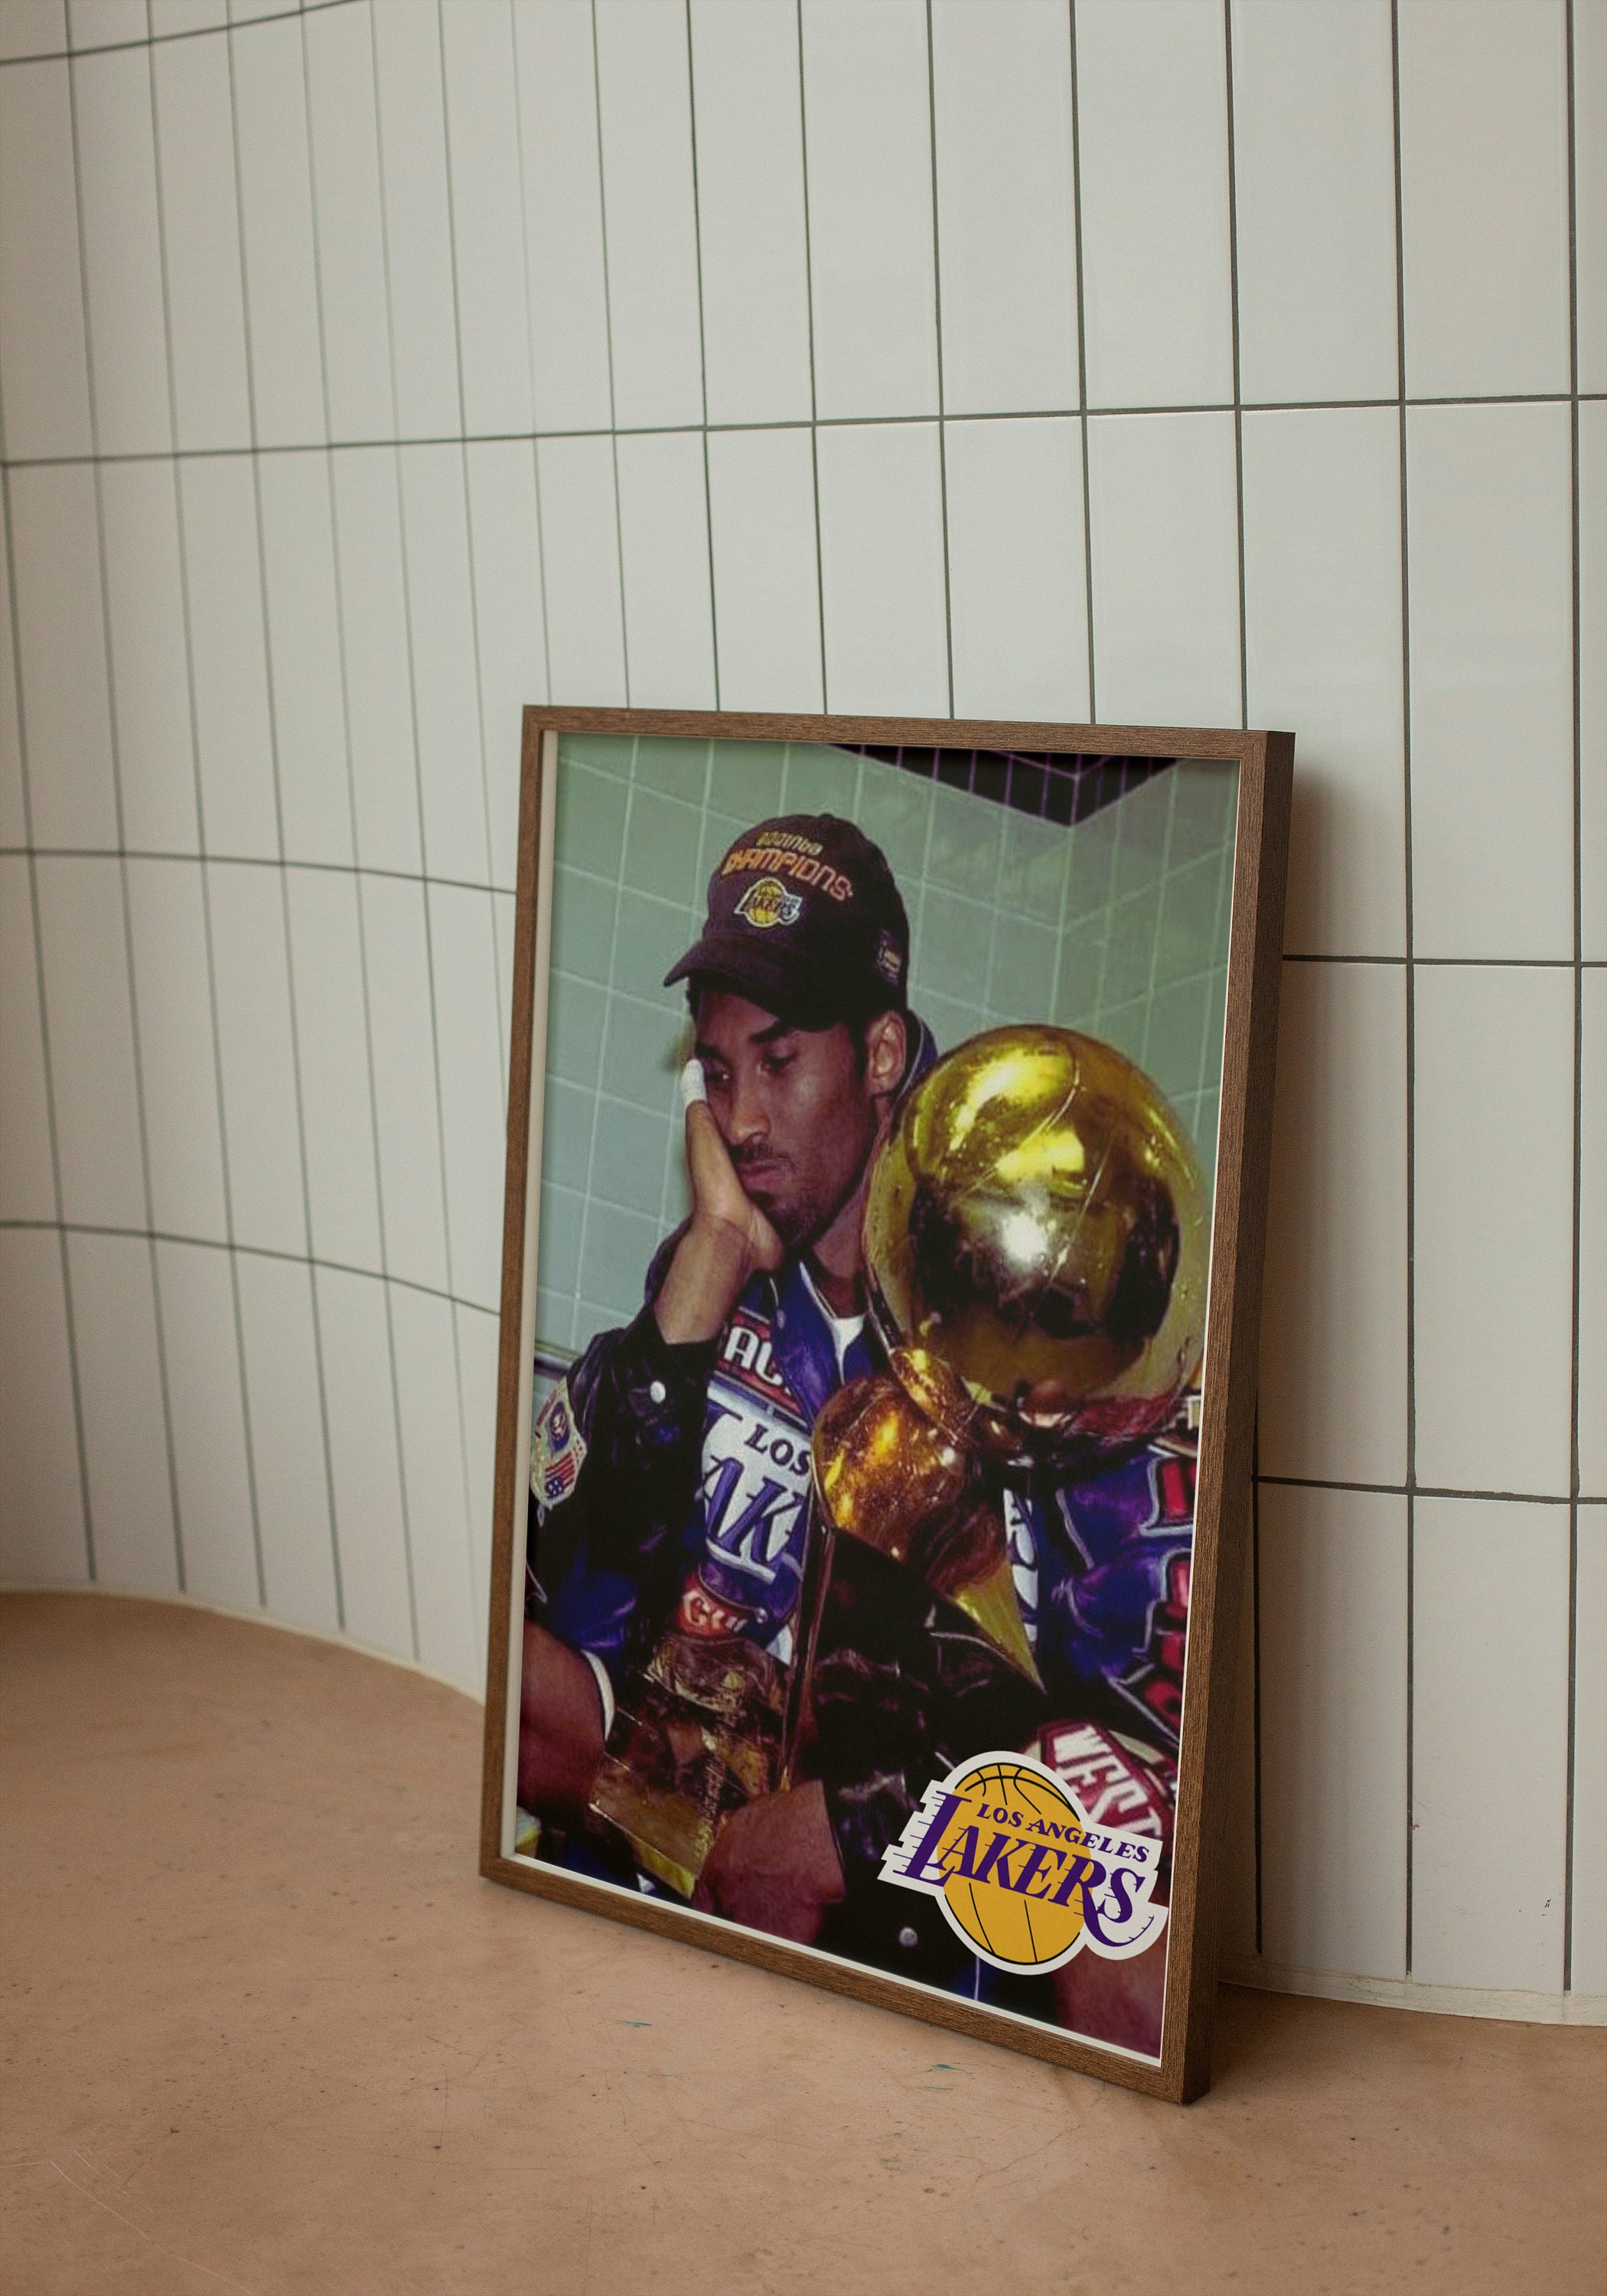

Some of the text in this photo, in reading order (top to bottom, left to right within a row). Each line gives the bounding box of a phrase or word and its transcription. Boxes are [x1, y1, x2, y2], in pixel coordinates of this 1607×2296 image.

[744, 1423, 810, 1476] LOS
[976, 1803, 1149, 1863] LOS ANGELES
[892, 1790, 1155, 1947] LAKERS
